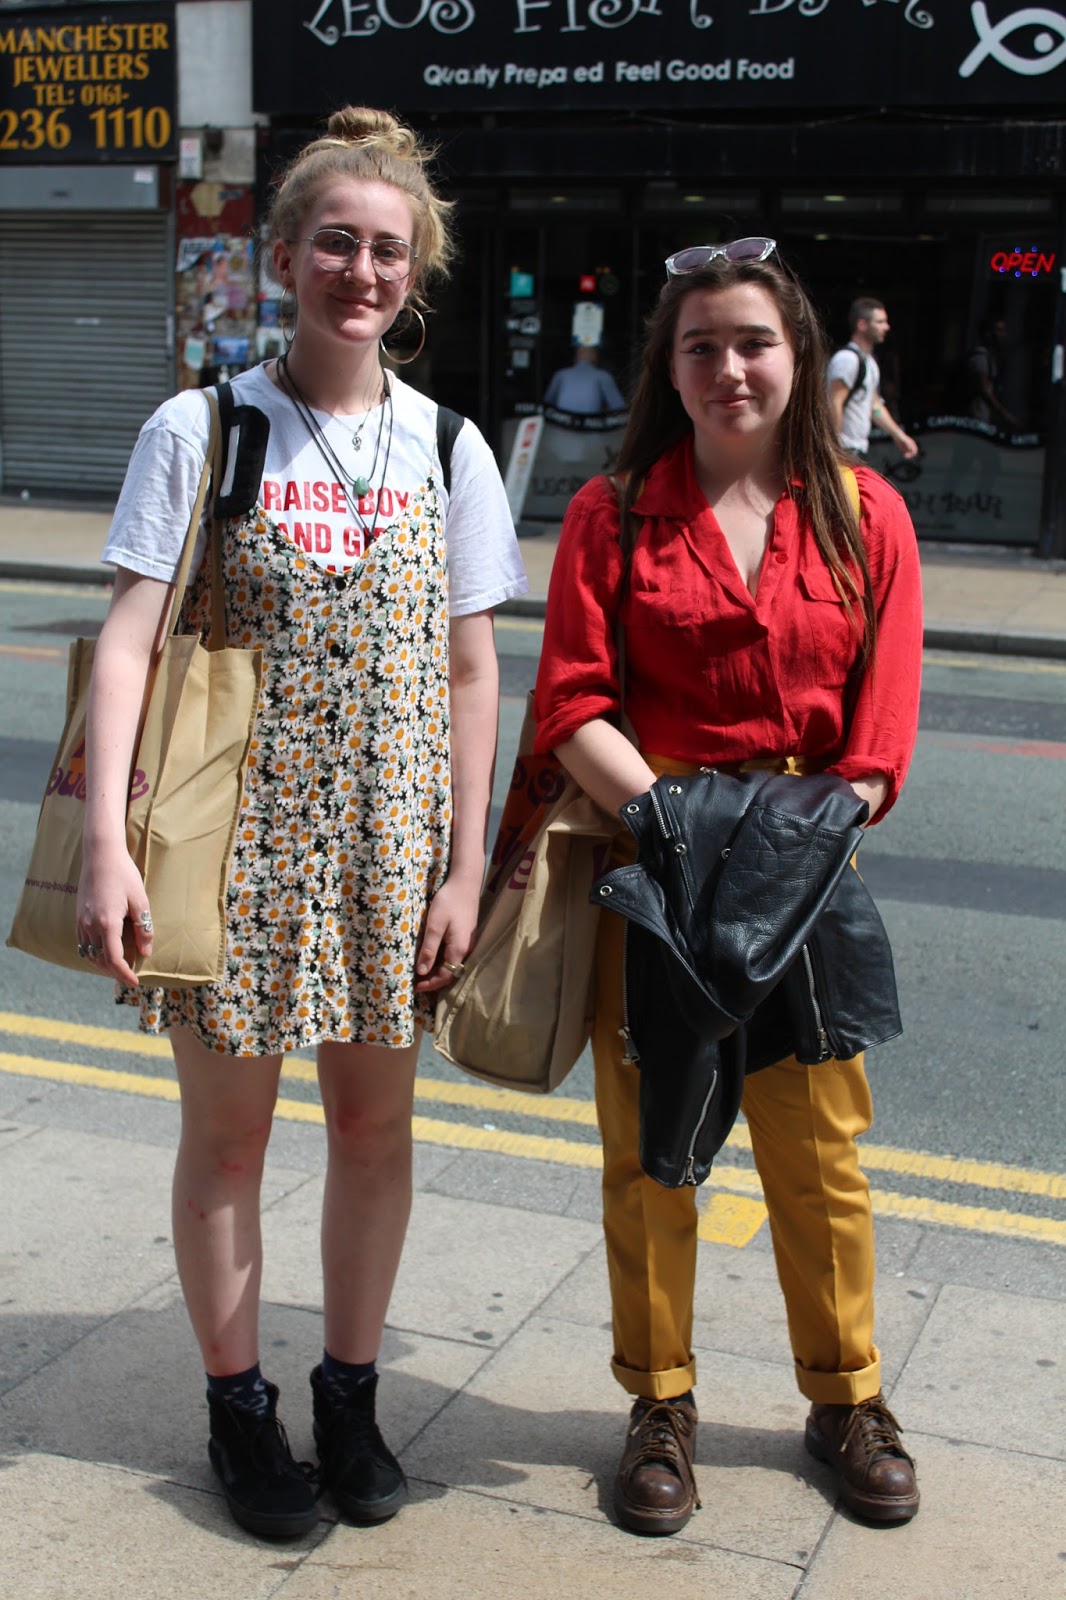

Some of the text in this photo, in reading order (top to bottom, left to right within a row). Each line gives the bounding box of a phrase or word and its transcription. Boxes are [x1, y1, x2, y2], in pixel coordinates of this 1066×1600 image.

[0, 22, 169, 54] MANCHESTER
[13, 52, 149, 87] JEWELLERS
[422, 63, 500, 89] Quaity
[615, 61, 660, 82] Feel
[666, 58, 731, 81] Good
[737, 57, 795, 80] Food
[33, 84, 75, 106] TEL:
[0, 106, 171, 150] 236 1110
[990, 251, 1056, 273] OPEN
[927, 415, 997, 436] CAPPUCCINO
[263, 480, 416, 518] RAISE BOY
